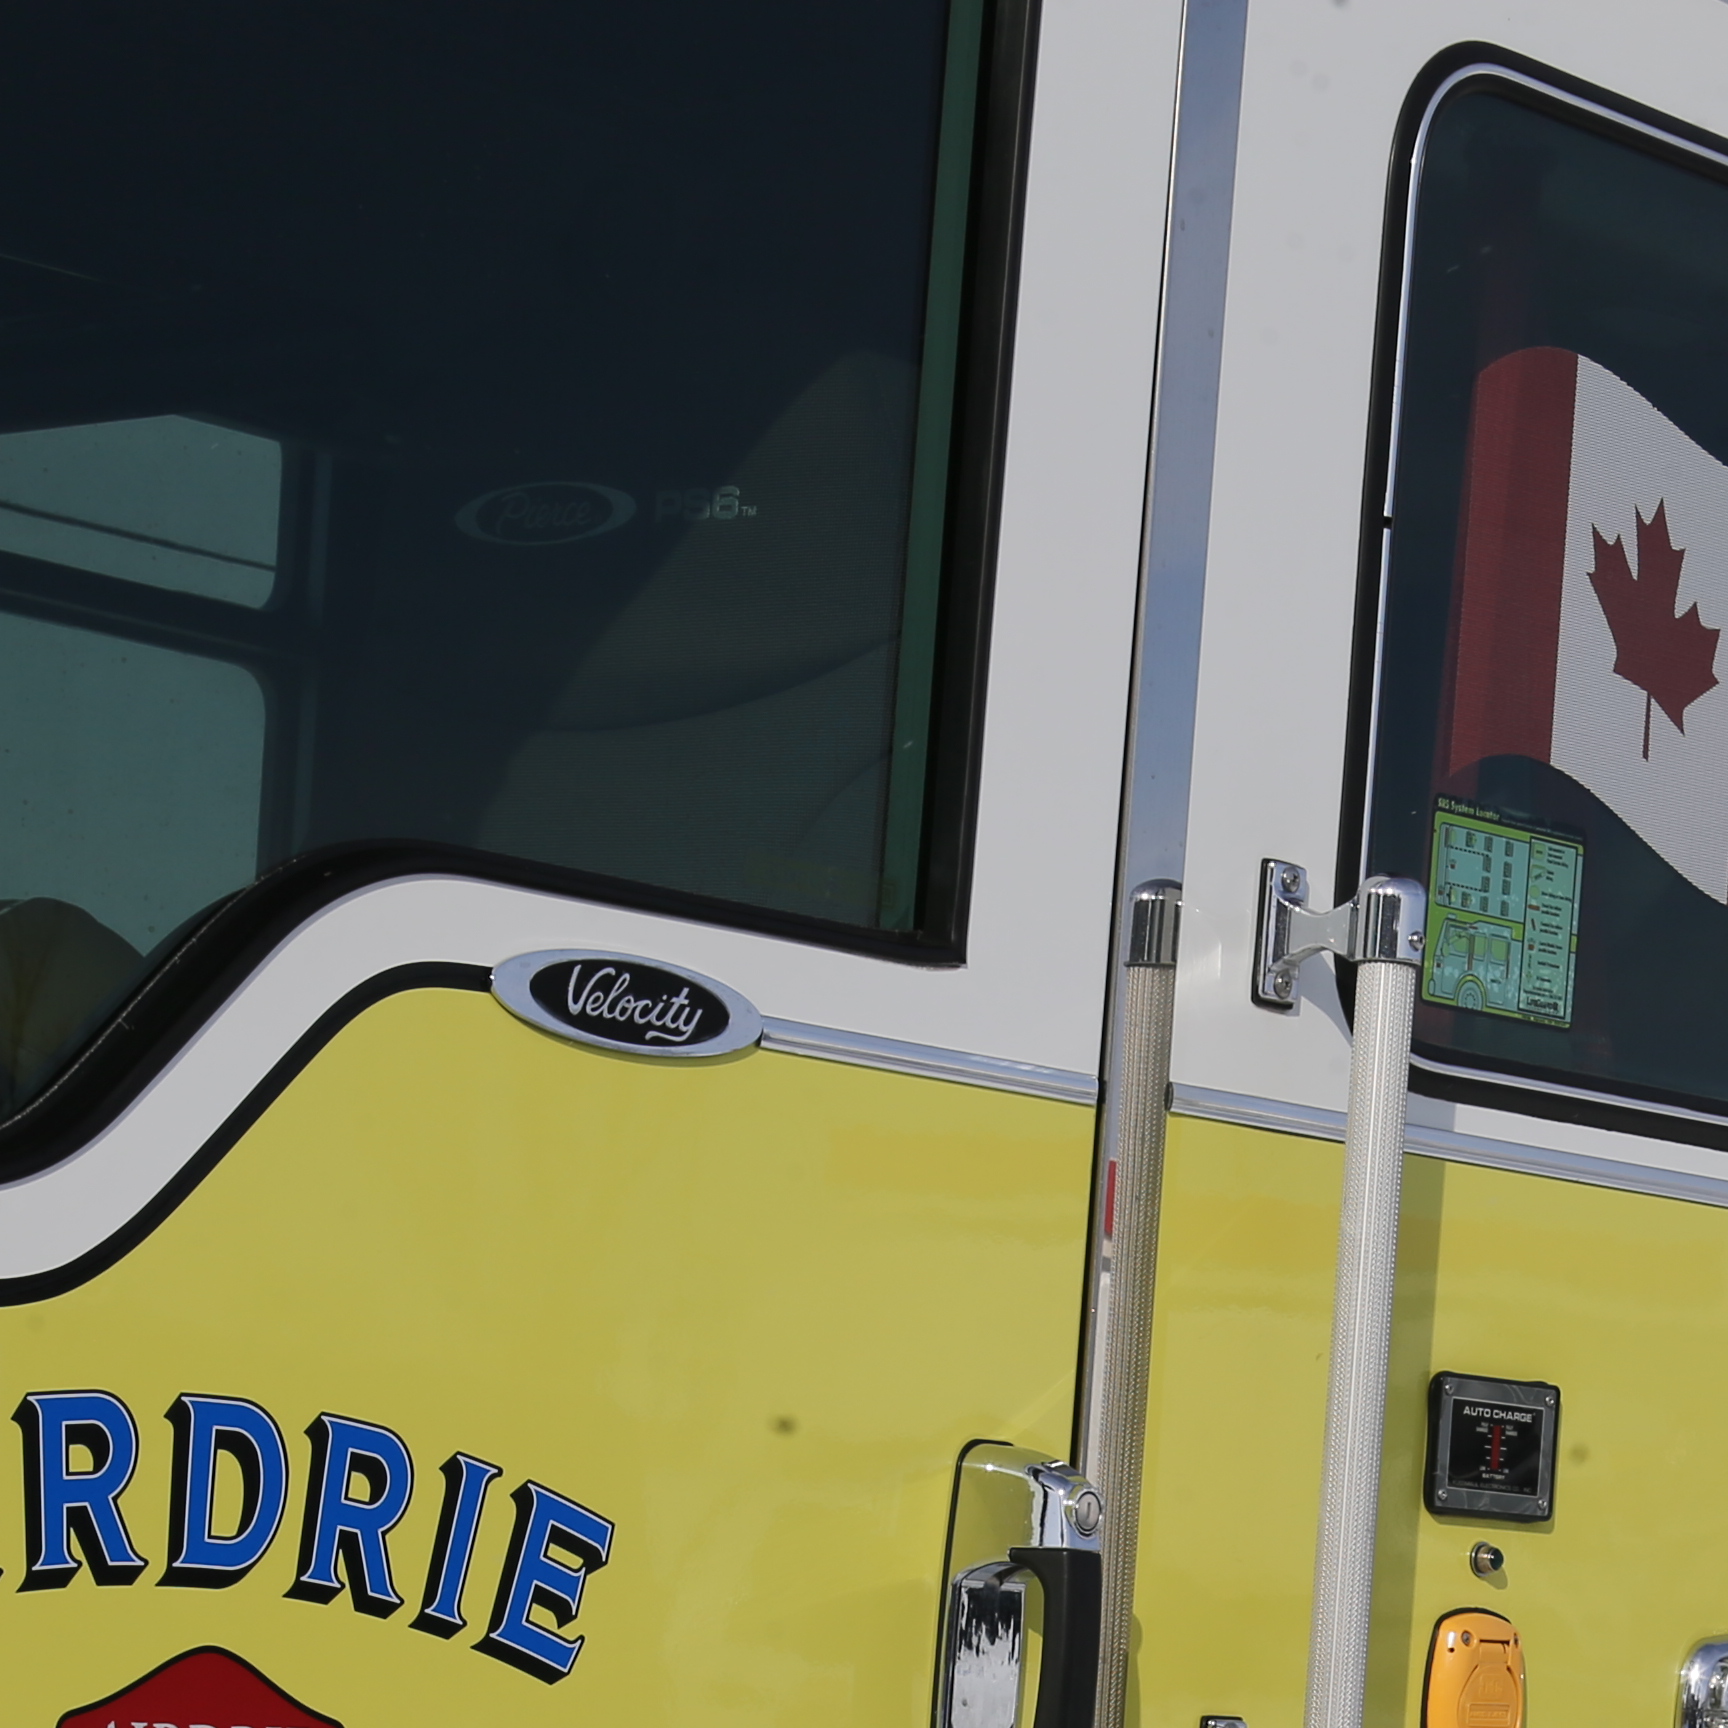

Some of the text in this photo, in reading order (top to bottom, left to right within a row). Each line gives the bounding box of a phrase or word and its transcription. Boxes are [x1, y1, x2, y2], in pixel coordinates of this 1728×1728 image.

[496, 492, 592, 537] Pierce
[1451, 801, 1474, 815] System
[567, 964, 703, 1042] Velocity
[1463, 1406, 1532, 1423] AUTO CHARGE
